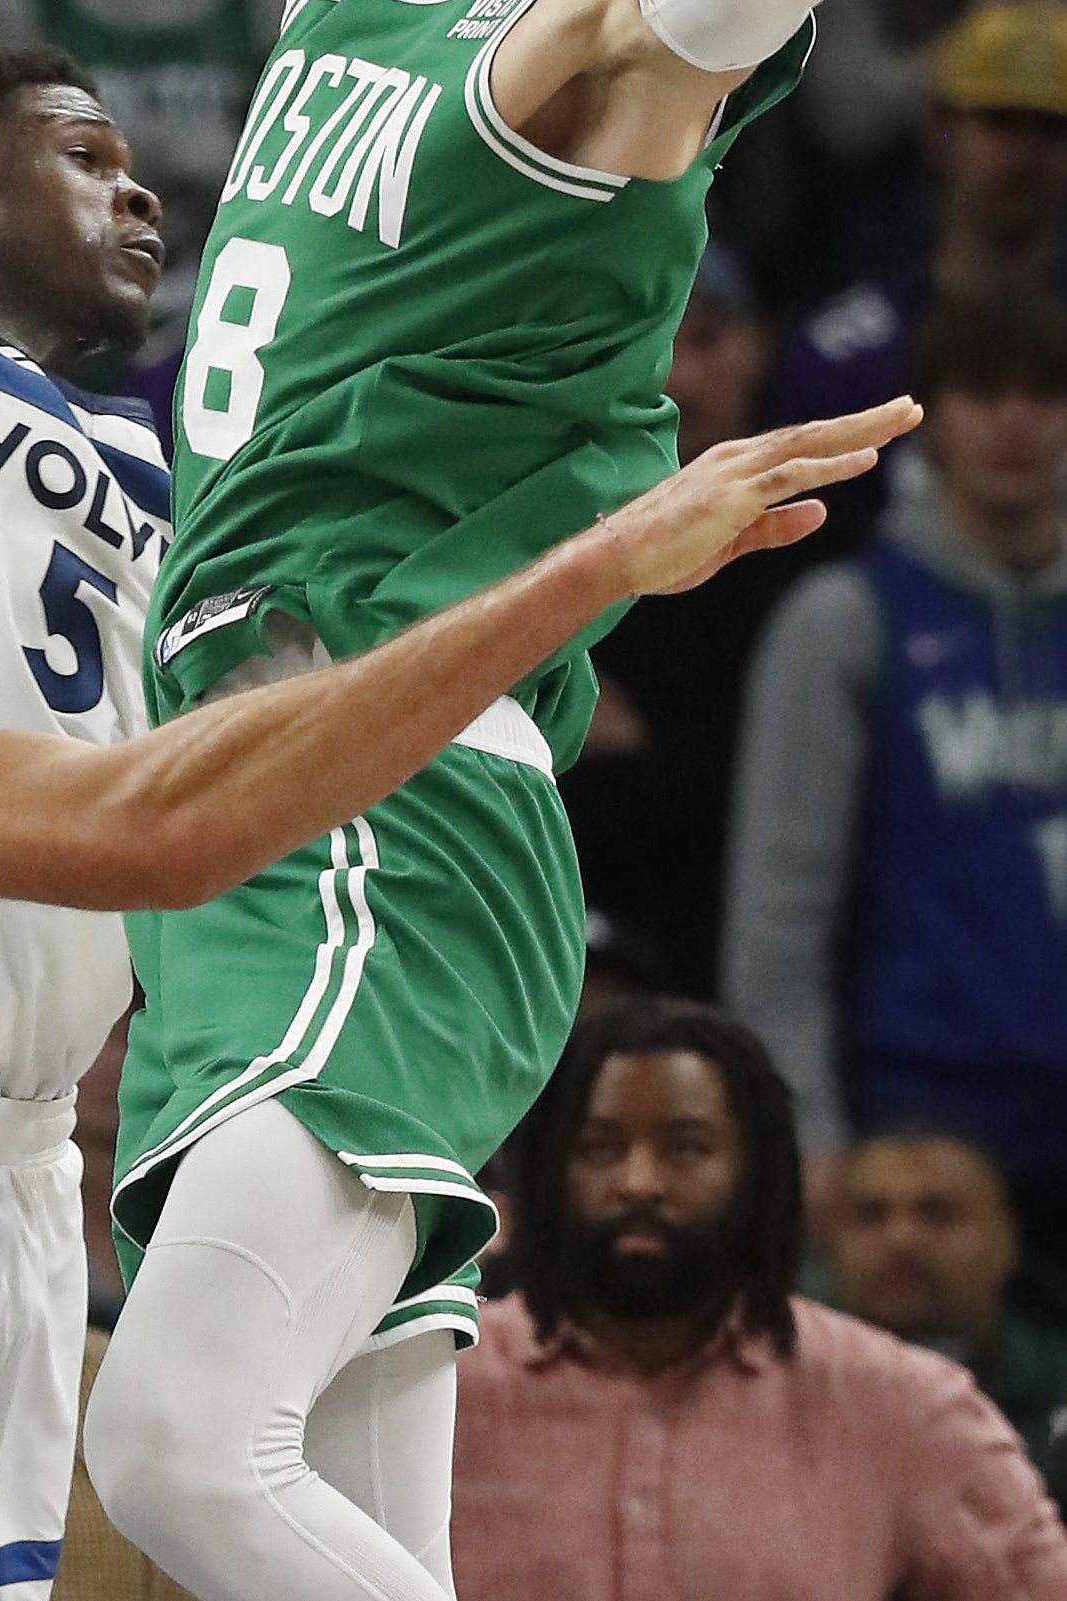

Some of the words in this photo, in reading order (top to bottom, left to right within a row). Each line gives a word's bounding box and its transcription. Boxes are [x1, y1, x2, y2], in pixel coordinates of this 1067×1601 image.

[446, 19, 502, 39] PRINT
[221, 49, 442, 249] OSTON
[183, 237, 291, 461] 8
[22, 540, 119, 714] 5
